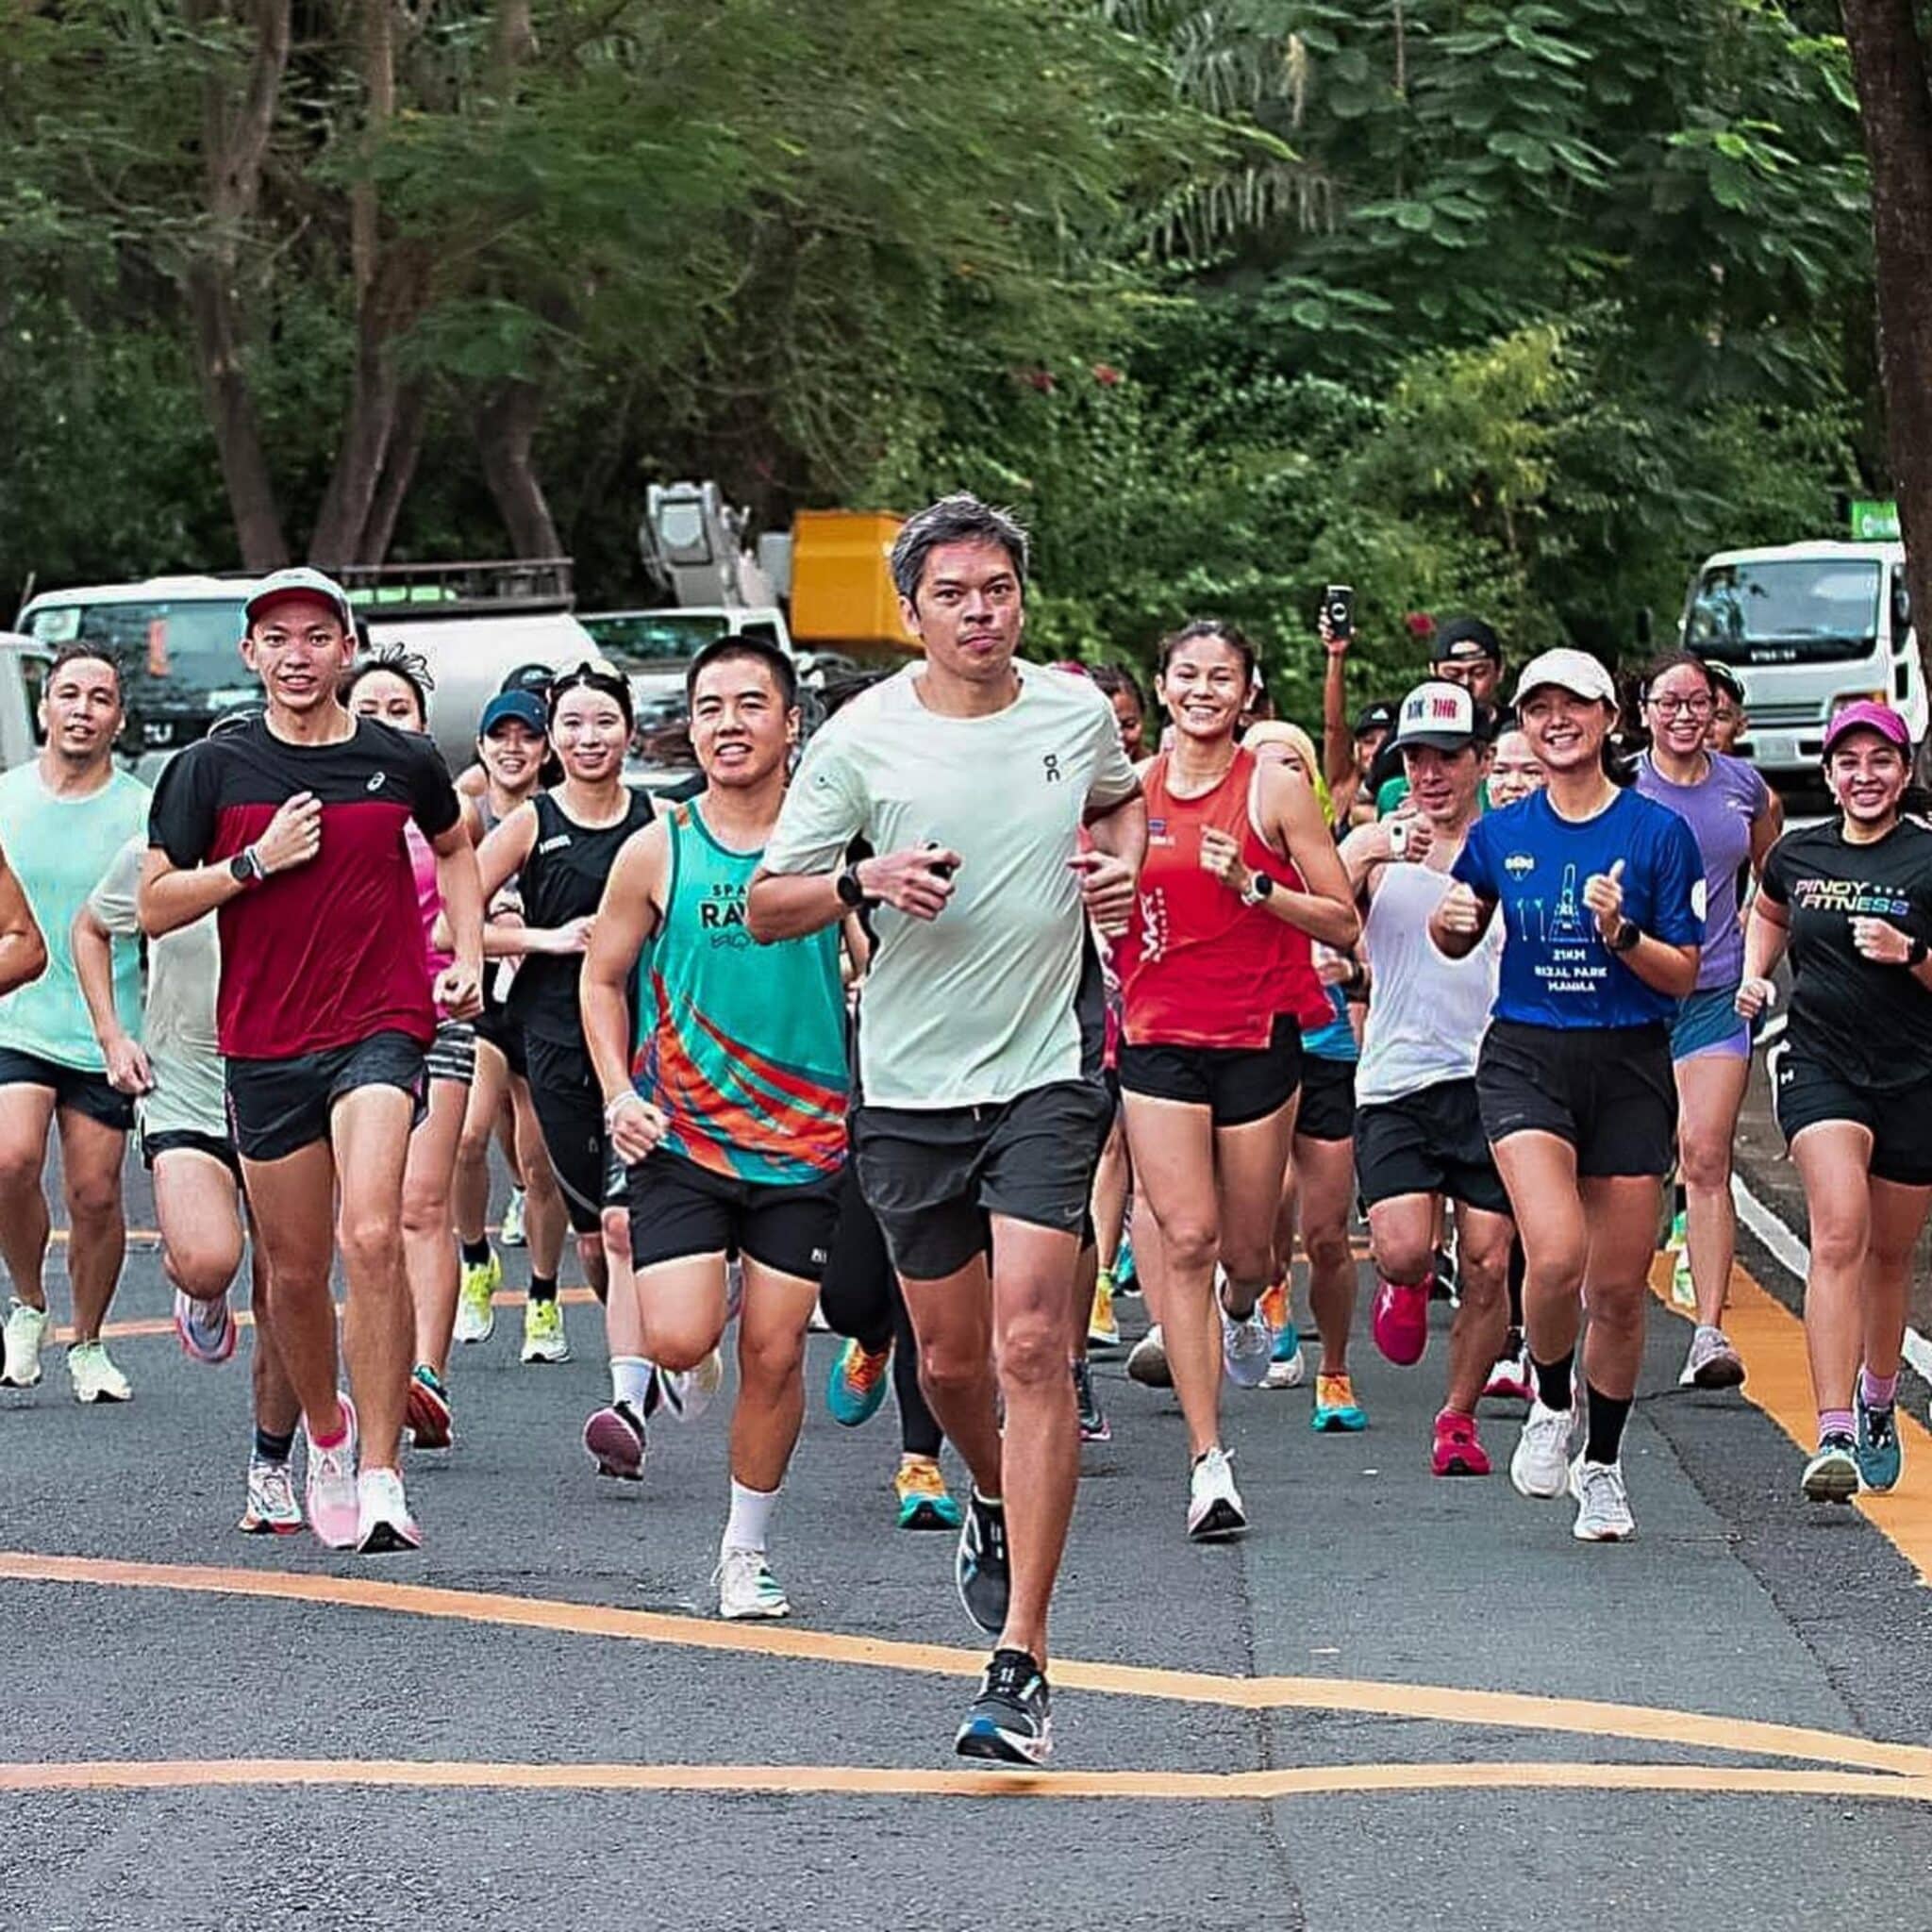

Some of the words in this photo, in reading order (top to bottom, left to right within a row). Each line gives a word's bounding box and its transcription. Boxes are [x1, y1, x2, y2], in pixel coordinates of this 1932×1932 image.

[1794, 879, 1871, 896] PINOY
[1800, 894, 1910, 916] FITNESS
[1534, 965, 1572, 978] RIZAL
[1573, 966, 1607, 978] PARK
